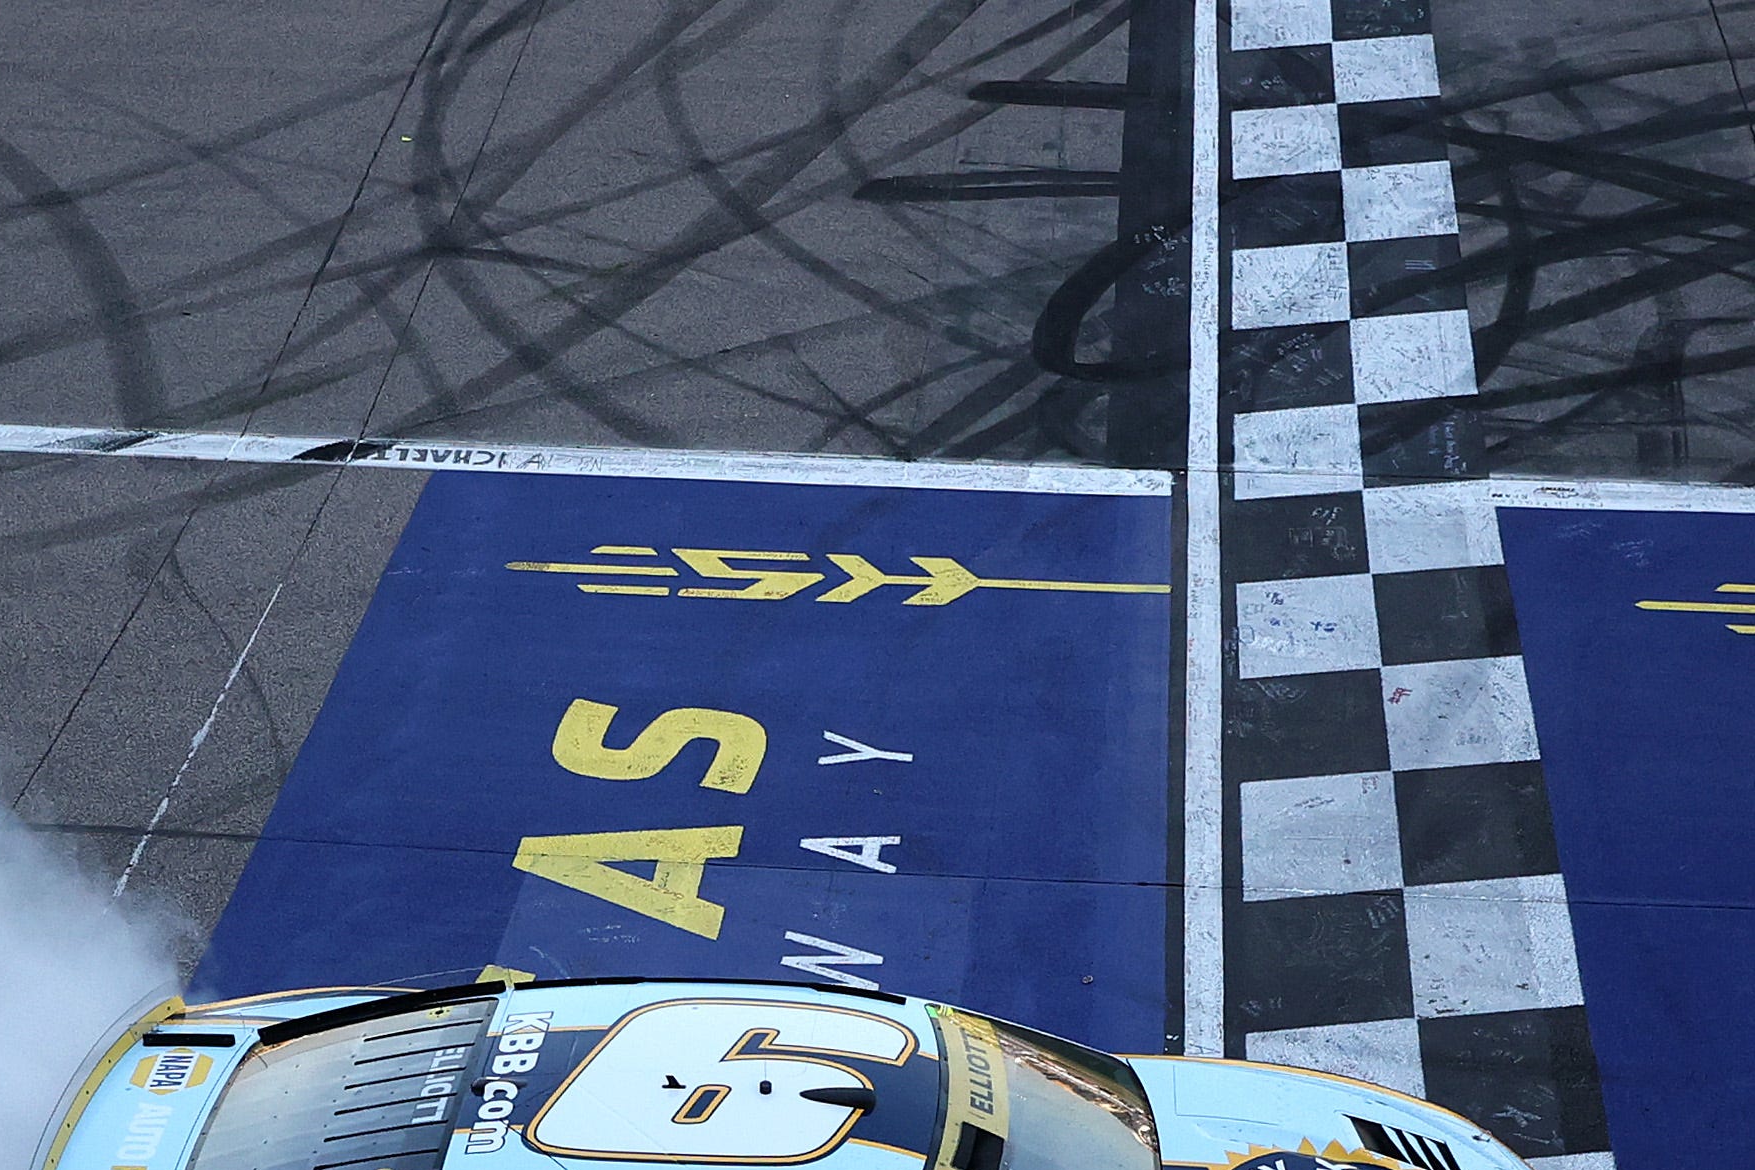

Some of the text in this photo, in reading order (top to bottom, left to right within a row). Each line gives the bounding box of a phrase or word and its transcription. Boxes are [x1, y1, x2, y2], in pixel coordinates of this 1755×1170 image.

[149, 1055, 194, 1089] NAPA
[465, 1011, 554, 1155] KBB.com
[521, 997, 919, 1166] 9
[116, 1102, 173, 1160] AUTO
